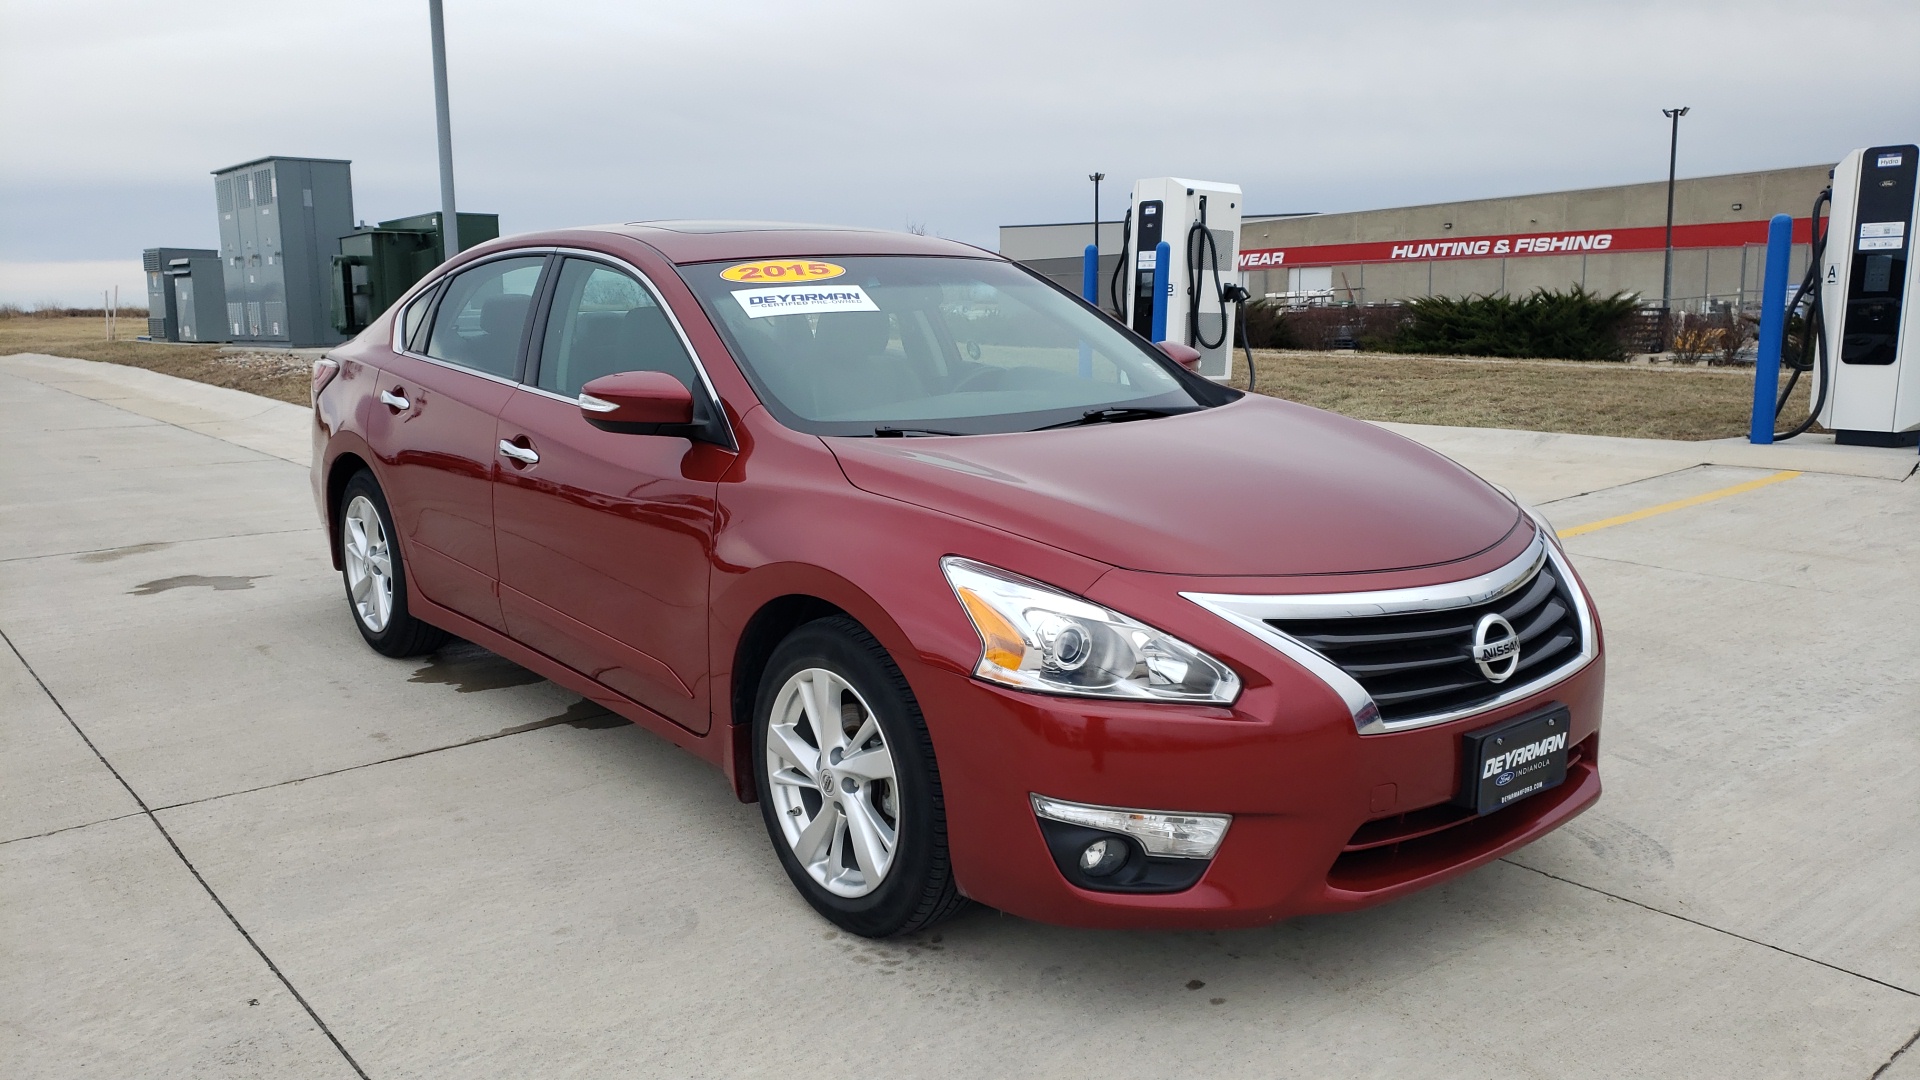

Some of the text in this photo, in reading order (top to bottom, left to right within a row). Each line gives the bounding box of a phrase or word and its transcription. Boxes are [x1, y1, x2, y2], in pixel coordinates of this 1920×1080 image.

[1391, 234, 1612, 258] HUNTING & FISHING
[738, 263, 831, 280] 2015
[1827, 265, 1836, 278] A
[749, 292, 861, 305] DEYARMAN
[1482, 638, 1520, 660] NISSAN
[1482, 731, 1568, 779] DEYARMAN
[1515, 758, 1550, 778] INDIANOLA
[1498, 772, 1513, 785] Ford
[1501, 781, 1543, 804] DEYARMANFORD.COM
